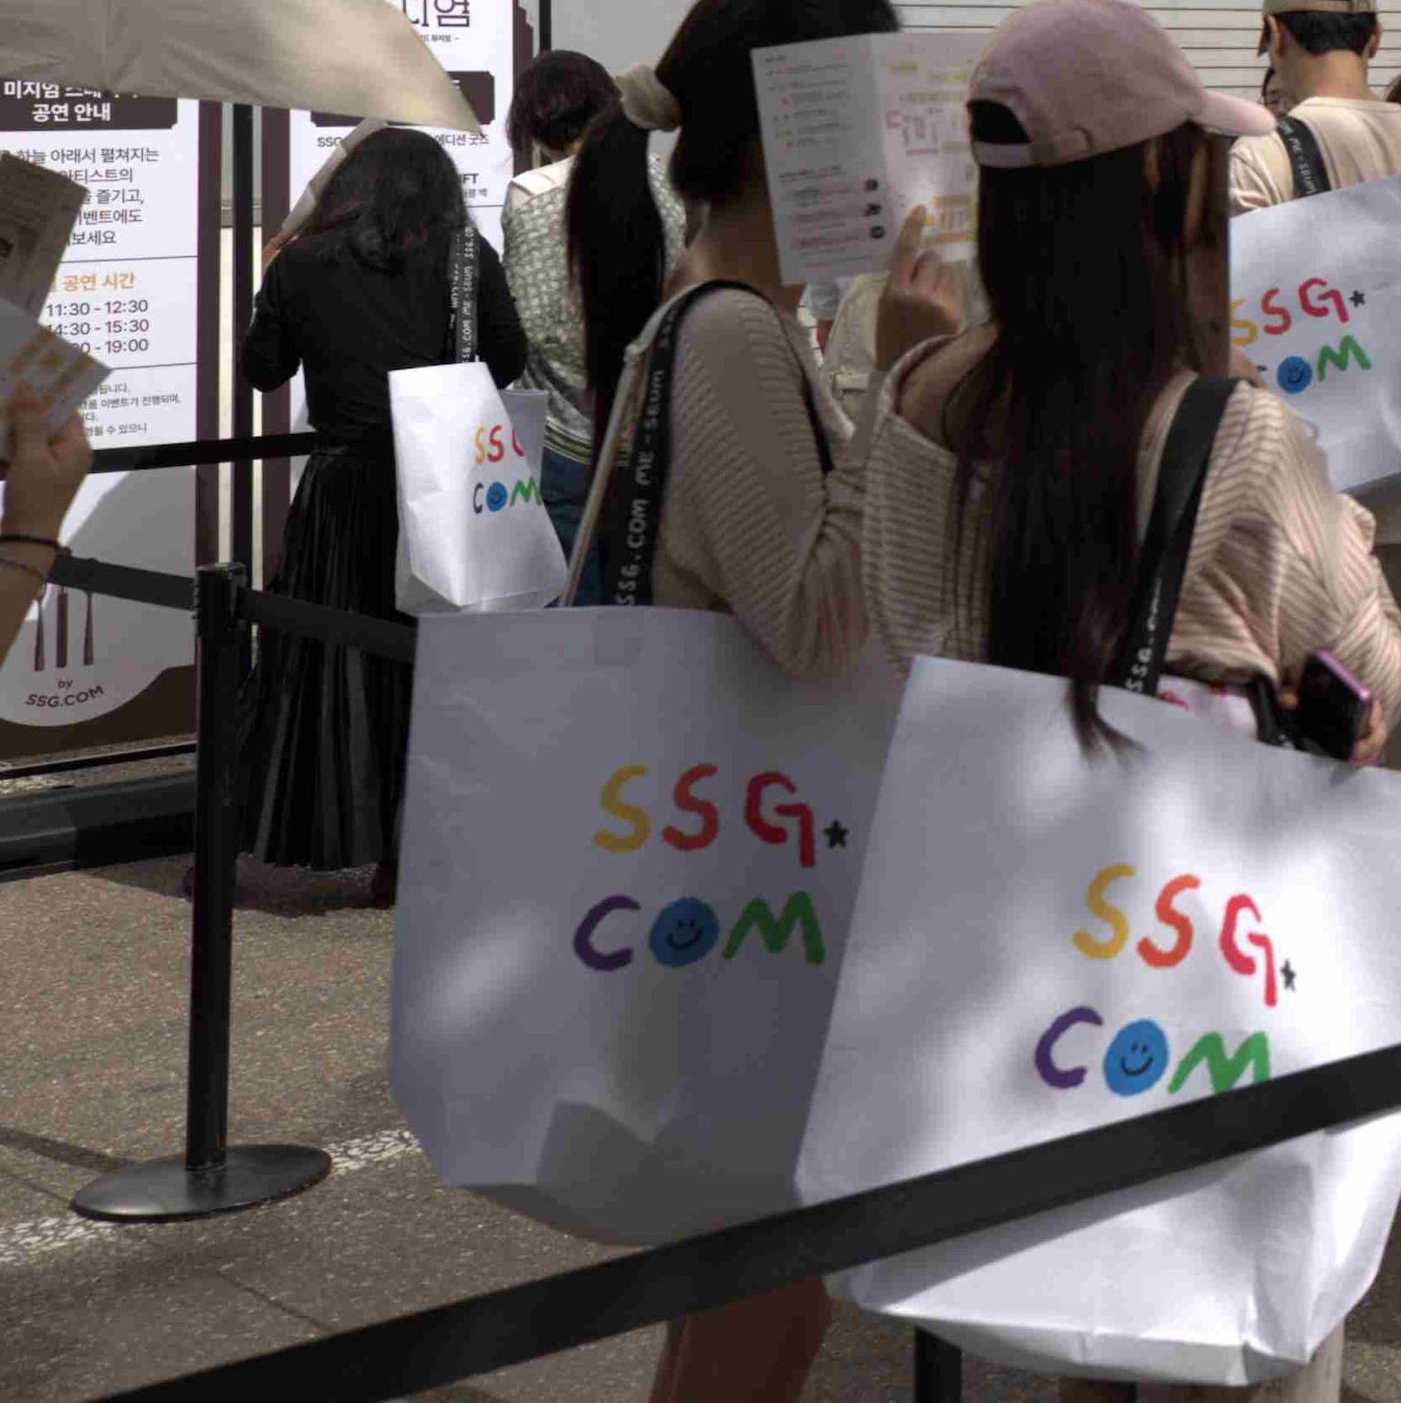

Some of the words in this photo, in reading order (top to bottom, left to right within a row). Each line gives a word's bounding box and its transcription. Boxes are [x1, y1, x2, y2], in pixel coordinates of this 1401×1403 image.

[32, 103, 69, 122] 공연
[74, 102, 111, 121] 안내
[51, 148, 96, 164] 아래서
[101, 147, 160, 163] 펼쳐지는
[96, 189, 145, 205] 즐기고,
[67, 230, 118, 246] 보세요
[63, 274, 97, 292] 공연
[102, 271, 136, 289] 시간
[47, 302, 91, 317] 11:30
[105, 299, 149, 314] 12:30
[105, 318, 150, 334] 15:30
[107, 338, 149, 354] 19:00
[1257, 335, 1372, 394] OM
[473, 477, 543, 514] COM
[58, 679, 73, 689] by
[25, 684, 104, 709] SSG.COM
[592, 763, 815, 868] SSG
[573, 891, 826, 972] COM
[1072, 862, 1278, 1007] SSG
[1034, 1005, 1272, 1097] COM
